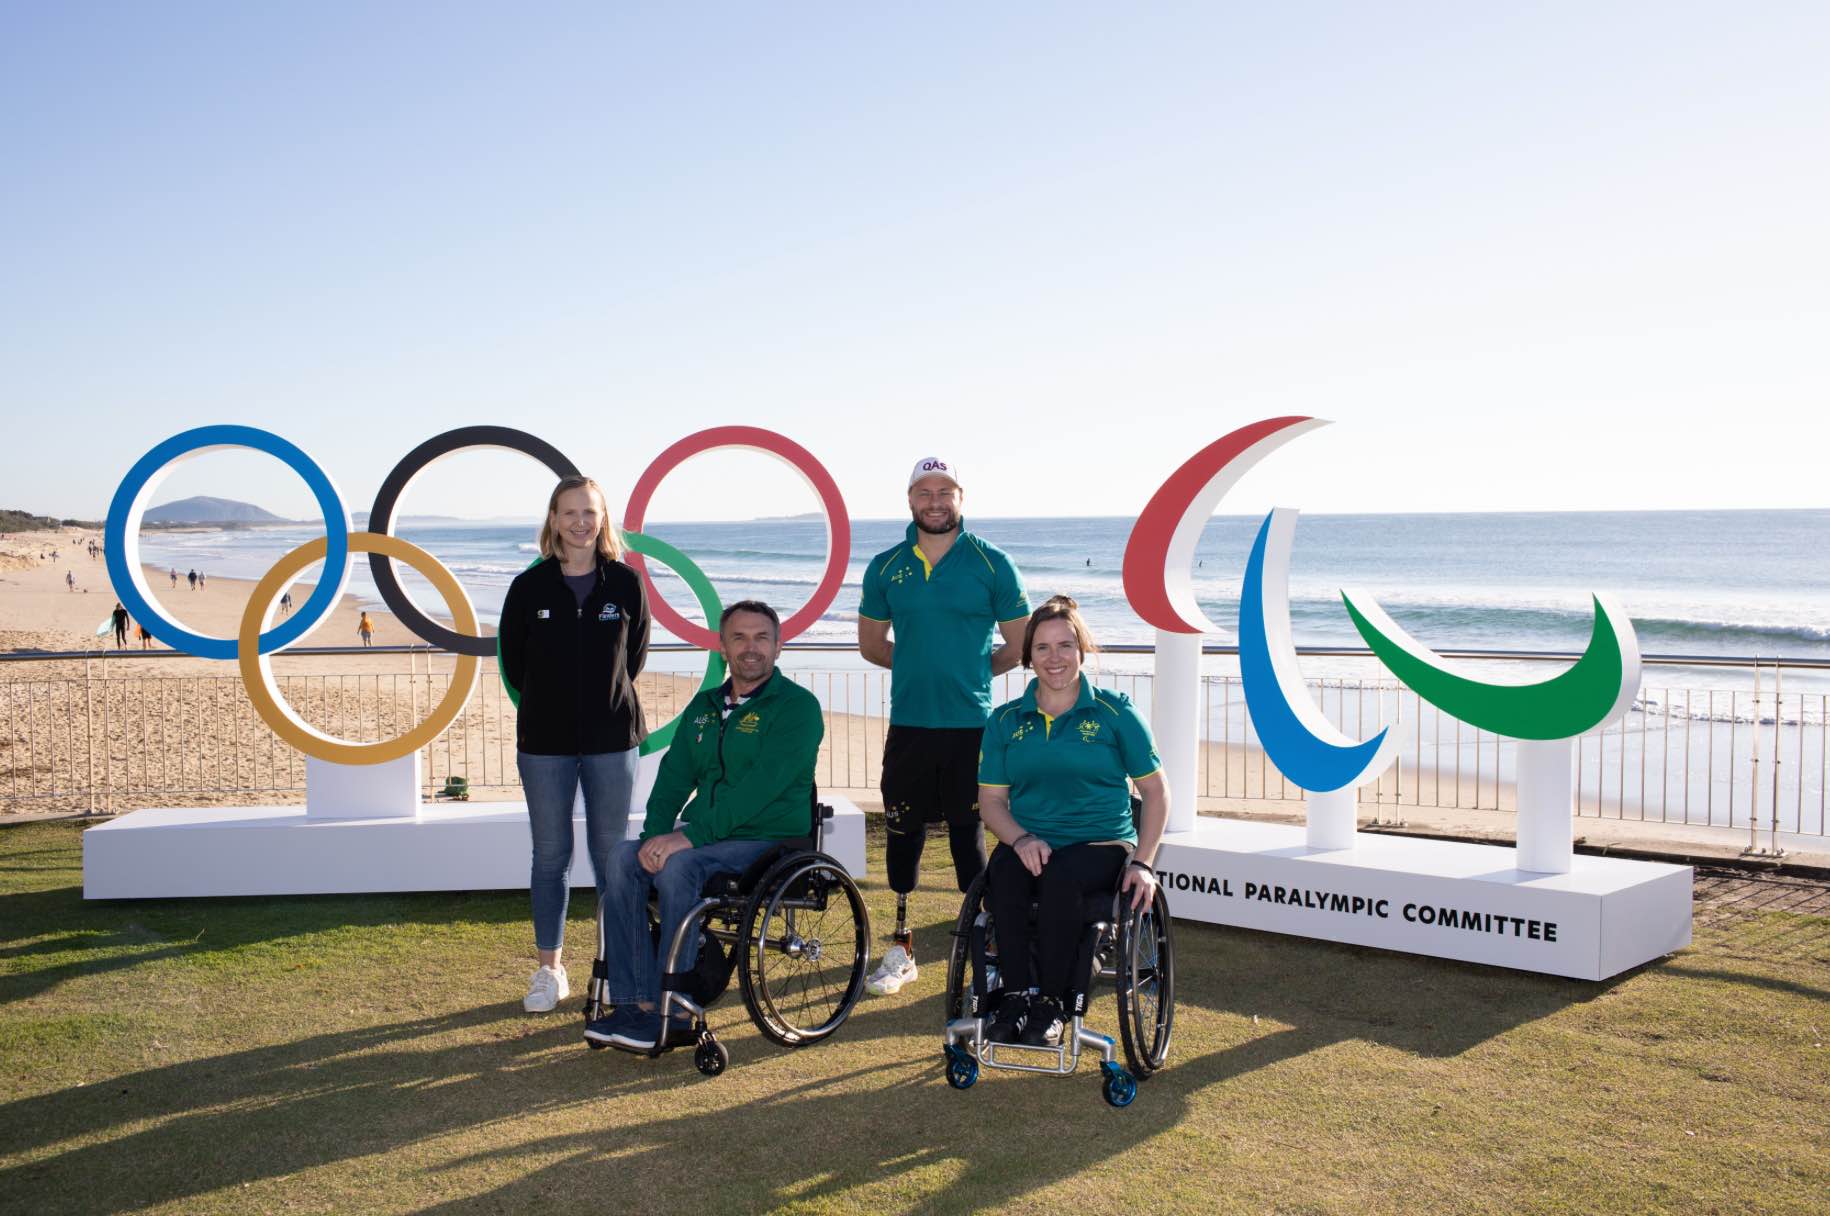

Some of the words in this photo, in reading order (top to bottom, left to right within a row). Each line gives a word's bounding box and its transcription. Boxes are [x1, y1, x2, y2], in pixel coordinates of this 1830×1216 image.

[922, 460, 948, 471] QAS
[1155, 870, 1234, 897] TIONAL
[1245, 882, 1389, 919] PARALYMPIC
[1402, 903, 1558, 943] COMMITTEE
